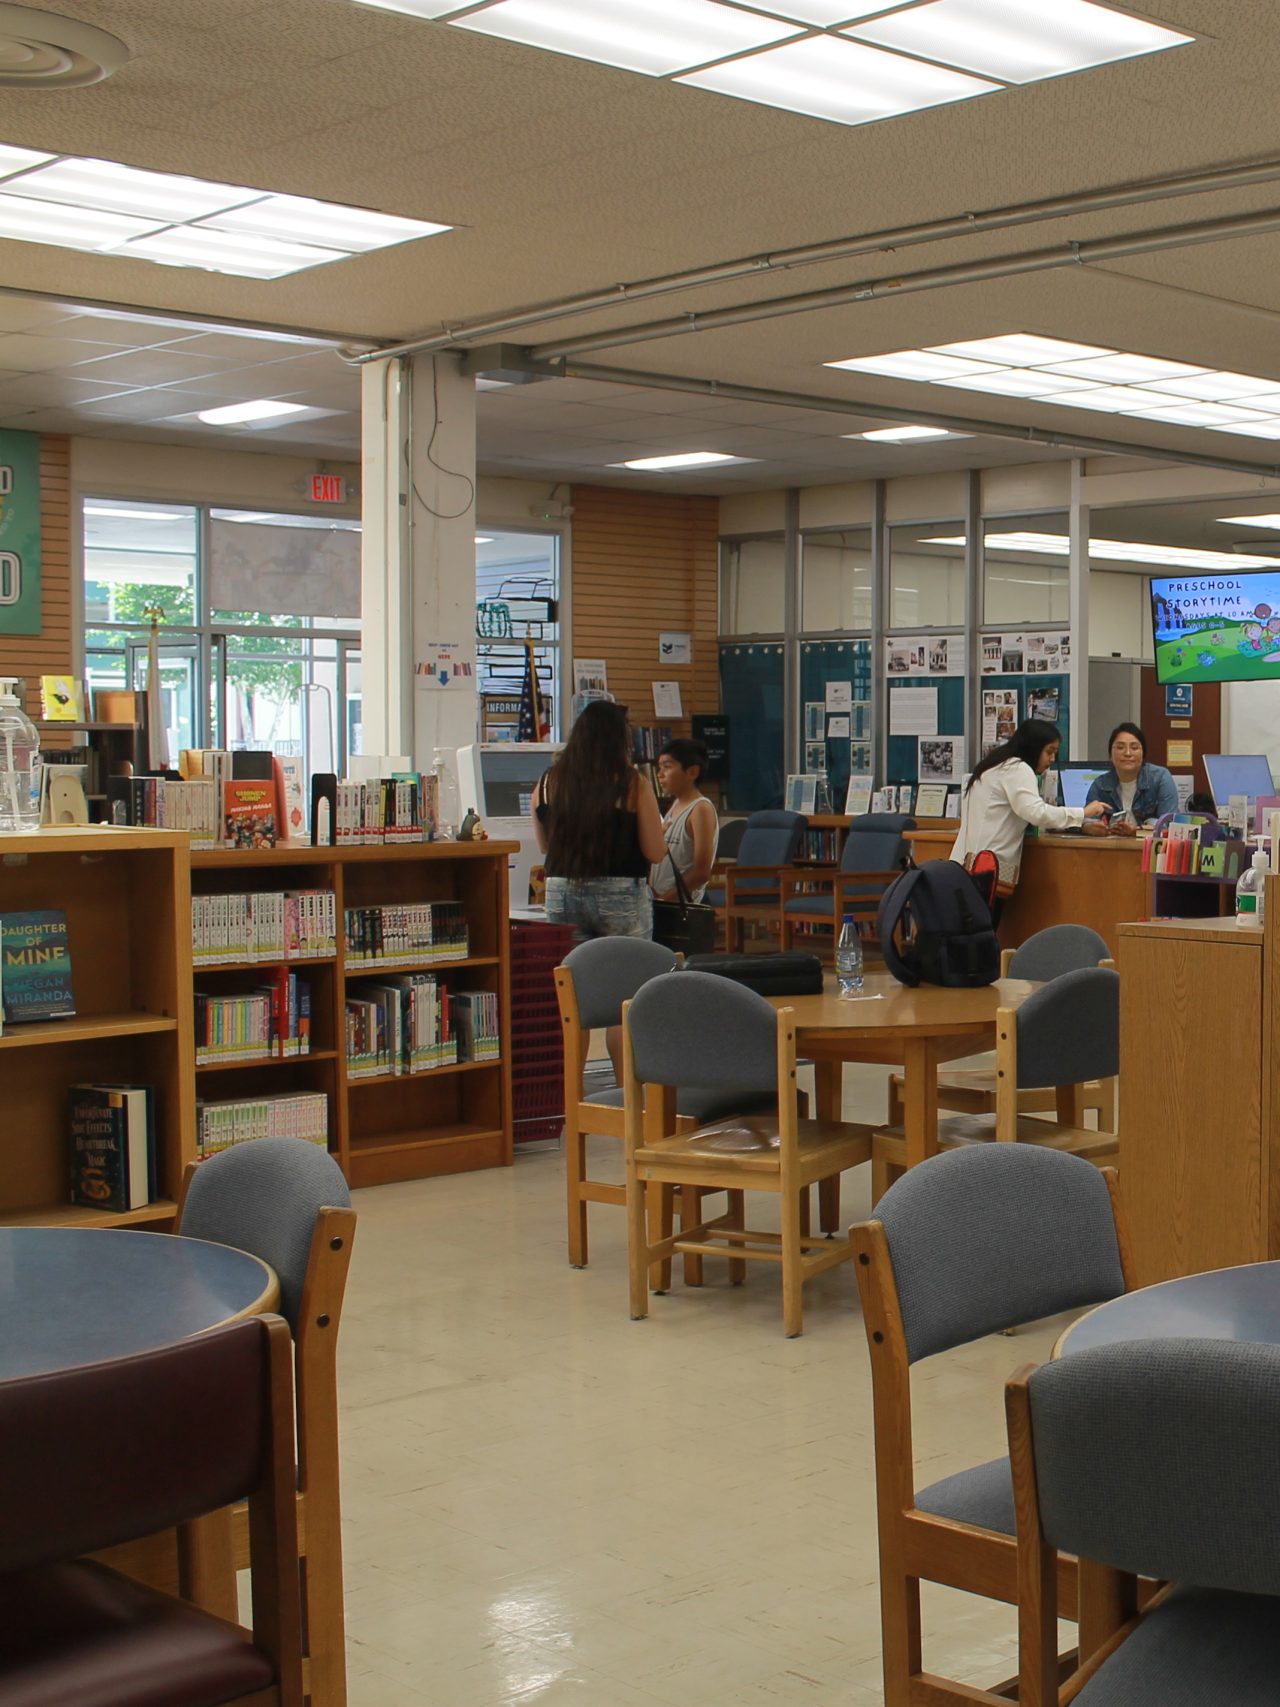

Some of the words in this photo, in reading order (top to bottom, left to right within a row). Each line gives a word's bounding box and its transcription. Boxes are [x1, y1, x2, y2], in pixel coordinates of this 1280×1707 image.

[312, 474, 342, 502] EXIT
[1168, 580, 1242, 592] PRESCHOOL
[1167, 595, 1241, 608] STORYTIME
[1202, 855, 1215, 866] M
[0, 924, 67, 937] DAUGHTER
[26, 937, 42, 946] OF
[7, 947, 65, 966] MINE
[7, 991, 73, 1004] MIRANDA
